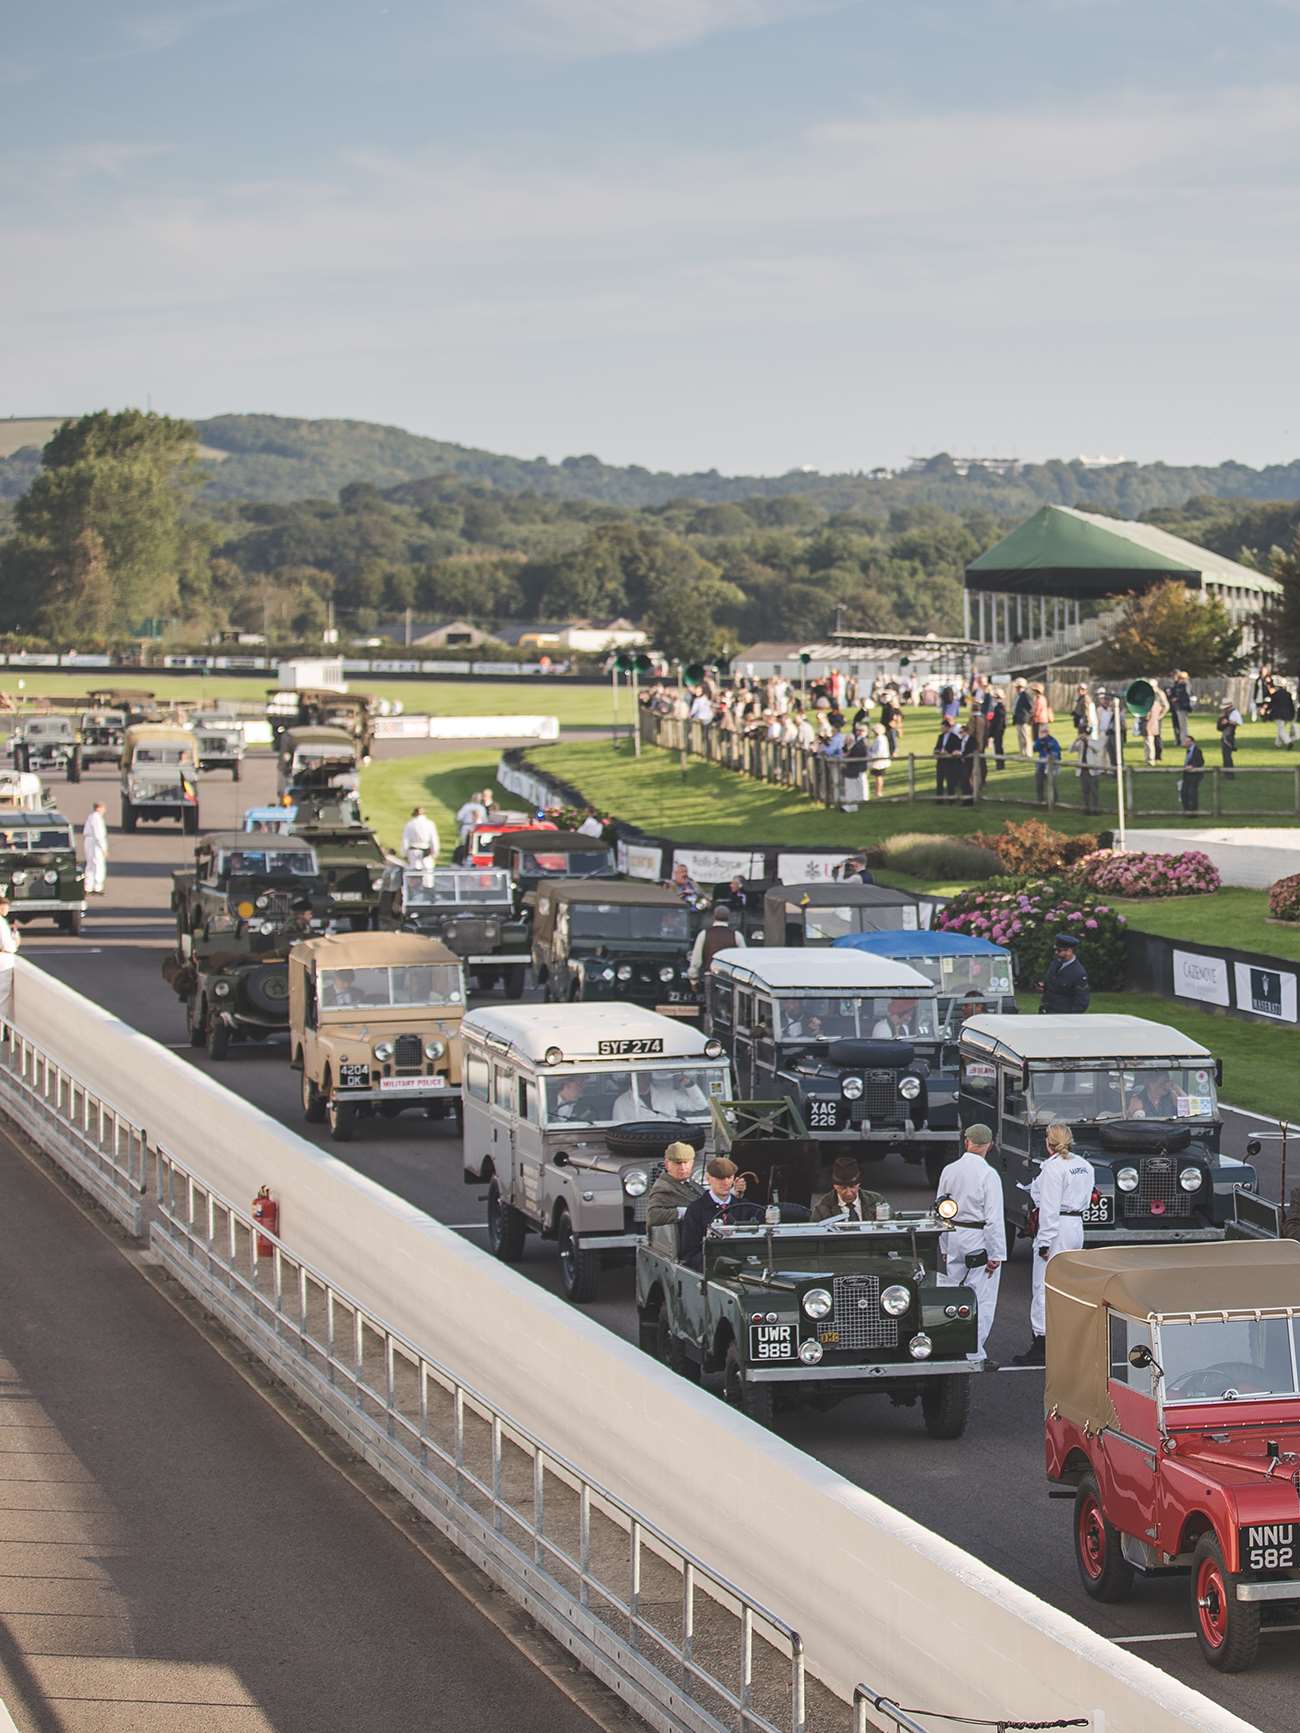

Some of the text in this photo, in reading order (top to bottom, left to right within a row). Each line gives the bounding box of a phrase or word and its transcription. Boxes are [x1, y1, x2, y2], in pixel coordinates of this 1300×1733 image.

[600, 1039, 661, 1055] SYF 274
[340, 1065, 369, 1075] 4204
[810, 1102, 837, 1114] XAC
[810, 1115, 837, 1126] 226
[1082, 1209, 1109, 1221] 829
[757, 1326, 791, 1342] UWR
[758, 1343, 792, 1358] 989
[1248, 1524, 1293, 1547] NNU
[1249, 1547, 1294, 1570] 582
